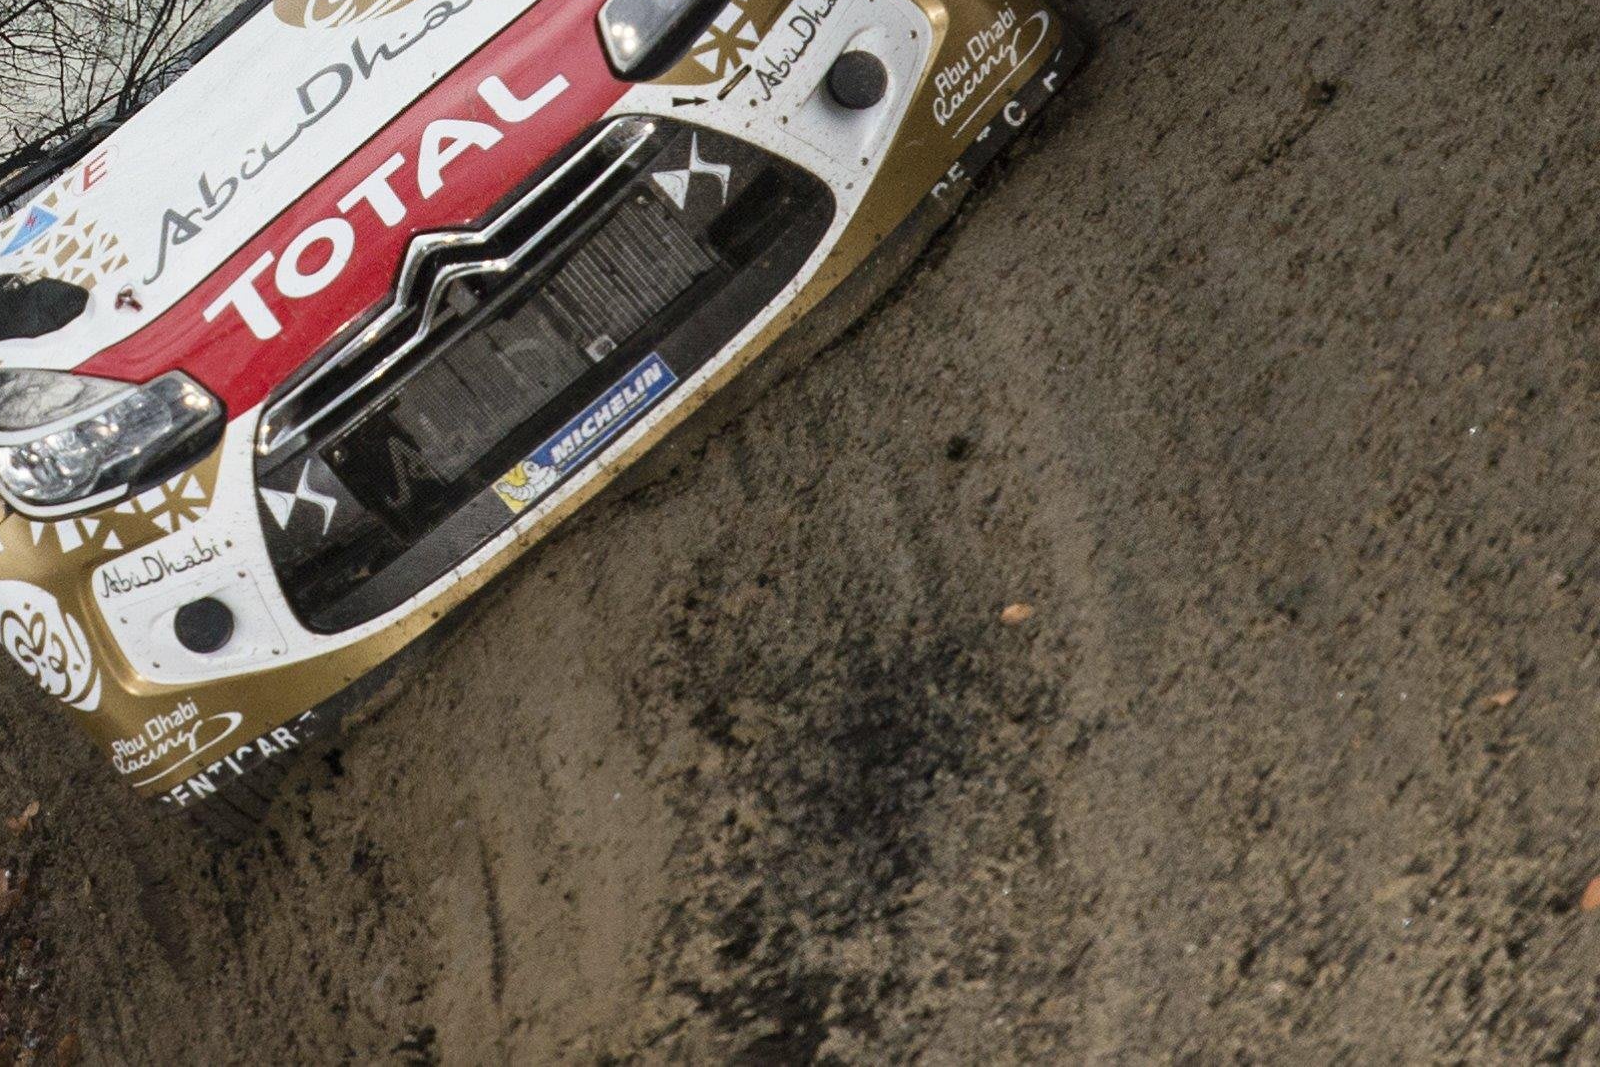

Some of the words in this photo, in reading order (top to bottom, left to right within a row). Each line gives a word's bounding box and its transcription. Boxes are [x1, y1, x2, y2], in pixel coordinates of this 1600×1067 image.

[966, 1, 1017, 63] Dhabi
[82, 149, 108, 192] E
[202, 73, 571, 341] TOTAL
[551, 362, 662, 464] MICHELIN
[144, 696, 199, 742] Dhabi
